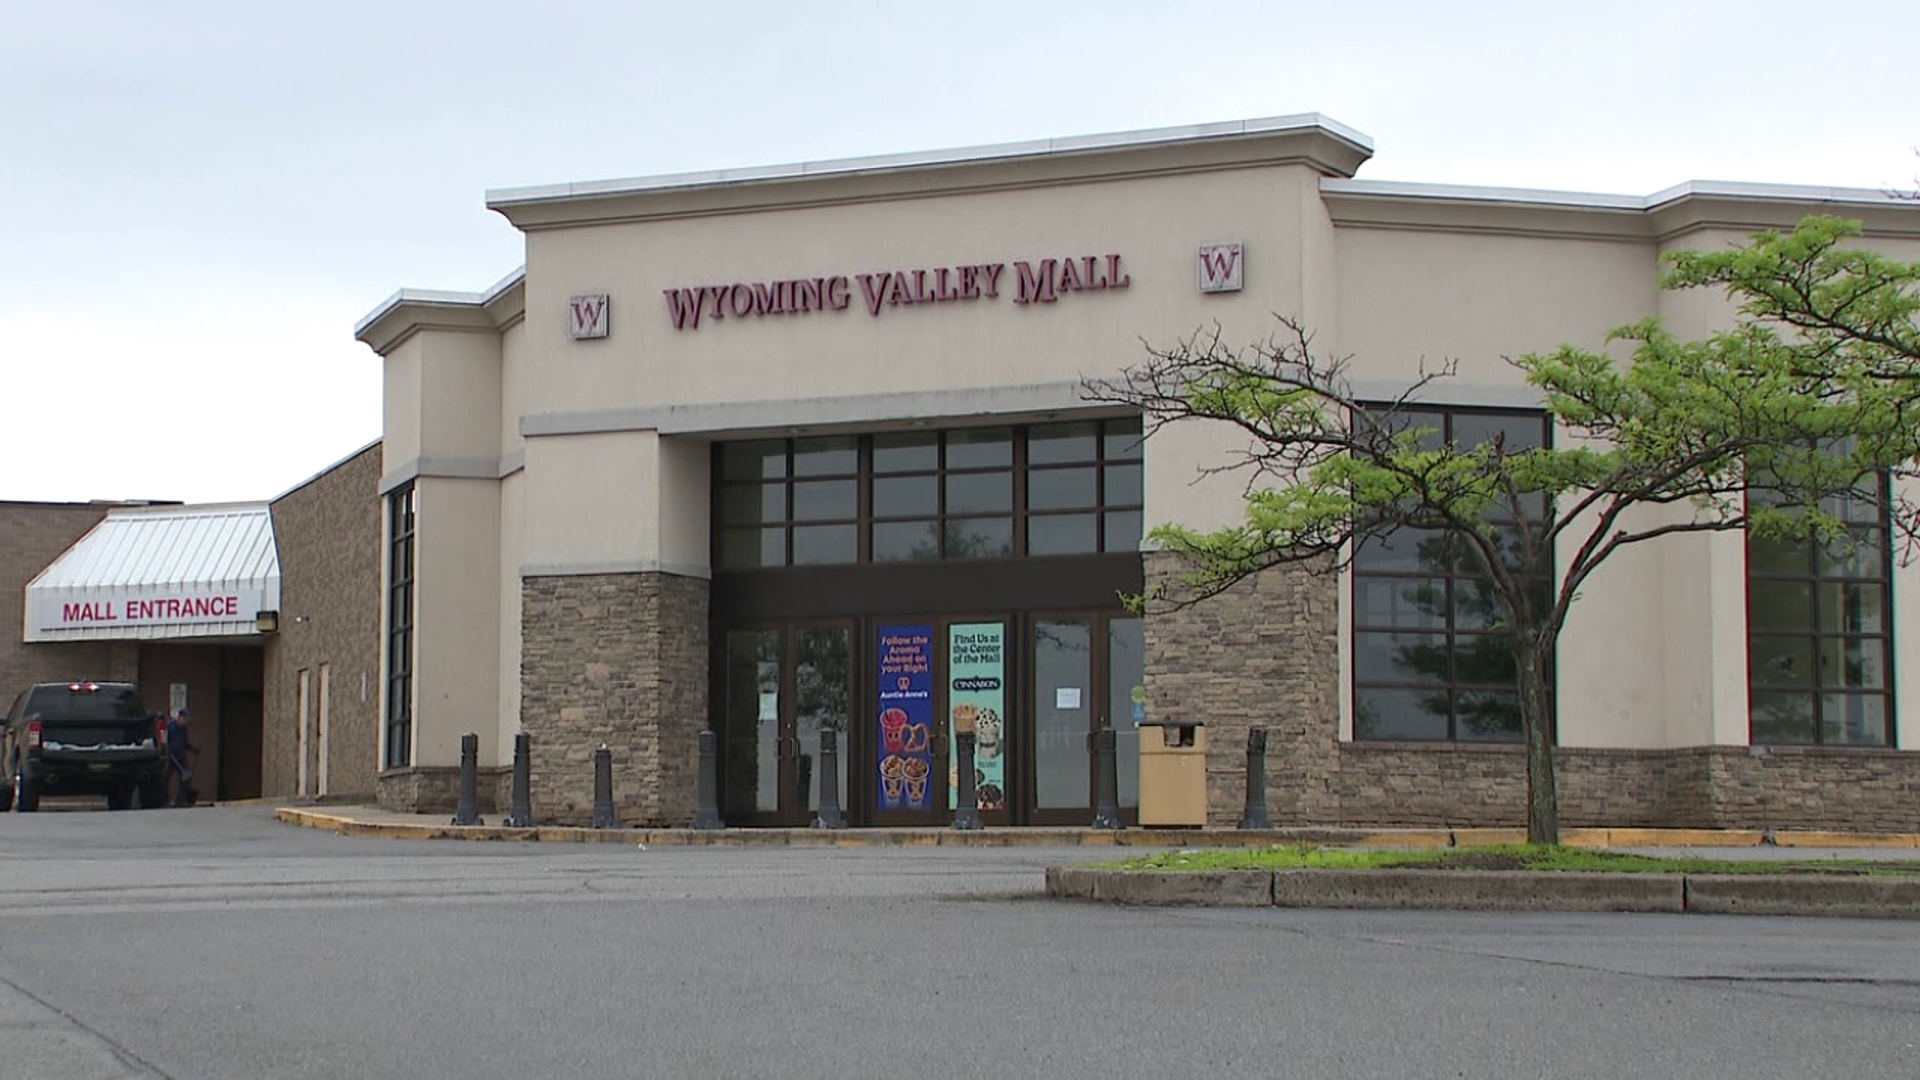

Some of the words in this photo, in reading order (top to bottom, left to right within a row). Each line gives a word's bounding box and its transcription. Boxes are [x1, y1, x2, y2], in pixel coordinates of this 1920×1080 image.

[663, 276, 852, 331] WYOMING
[855, 263, 1005, 318] VALLEY
[1013, 253, 1131, 304] MALL
[62, 602, 118, 622] MALL
[125, 596, 239, 619] ENTRANCE
[881, 636, 911, 646] Follow
[913, 635, 928, 644] the
[954, 634, 976, 644] Find
[977, 634, 989, 643] Us
[990, 634, 1000, 643] at
[889, 646, 920, 655] Aroma
[953, 645, 968, 654] the
[970, 644, 1001, 653] Center
[883, 655, 912, 664] Ahead
[914, 655, 927, 664] on
[953, 653, 963, 664] of
[964, 653, 979, 664] the
[980, 653, 1000, 664] Mall
[881, 665, 901, 675] your
[903, 664, 928, 673] Right
[880, 691, 903, 699] Auntie
